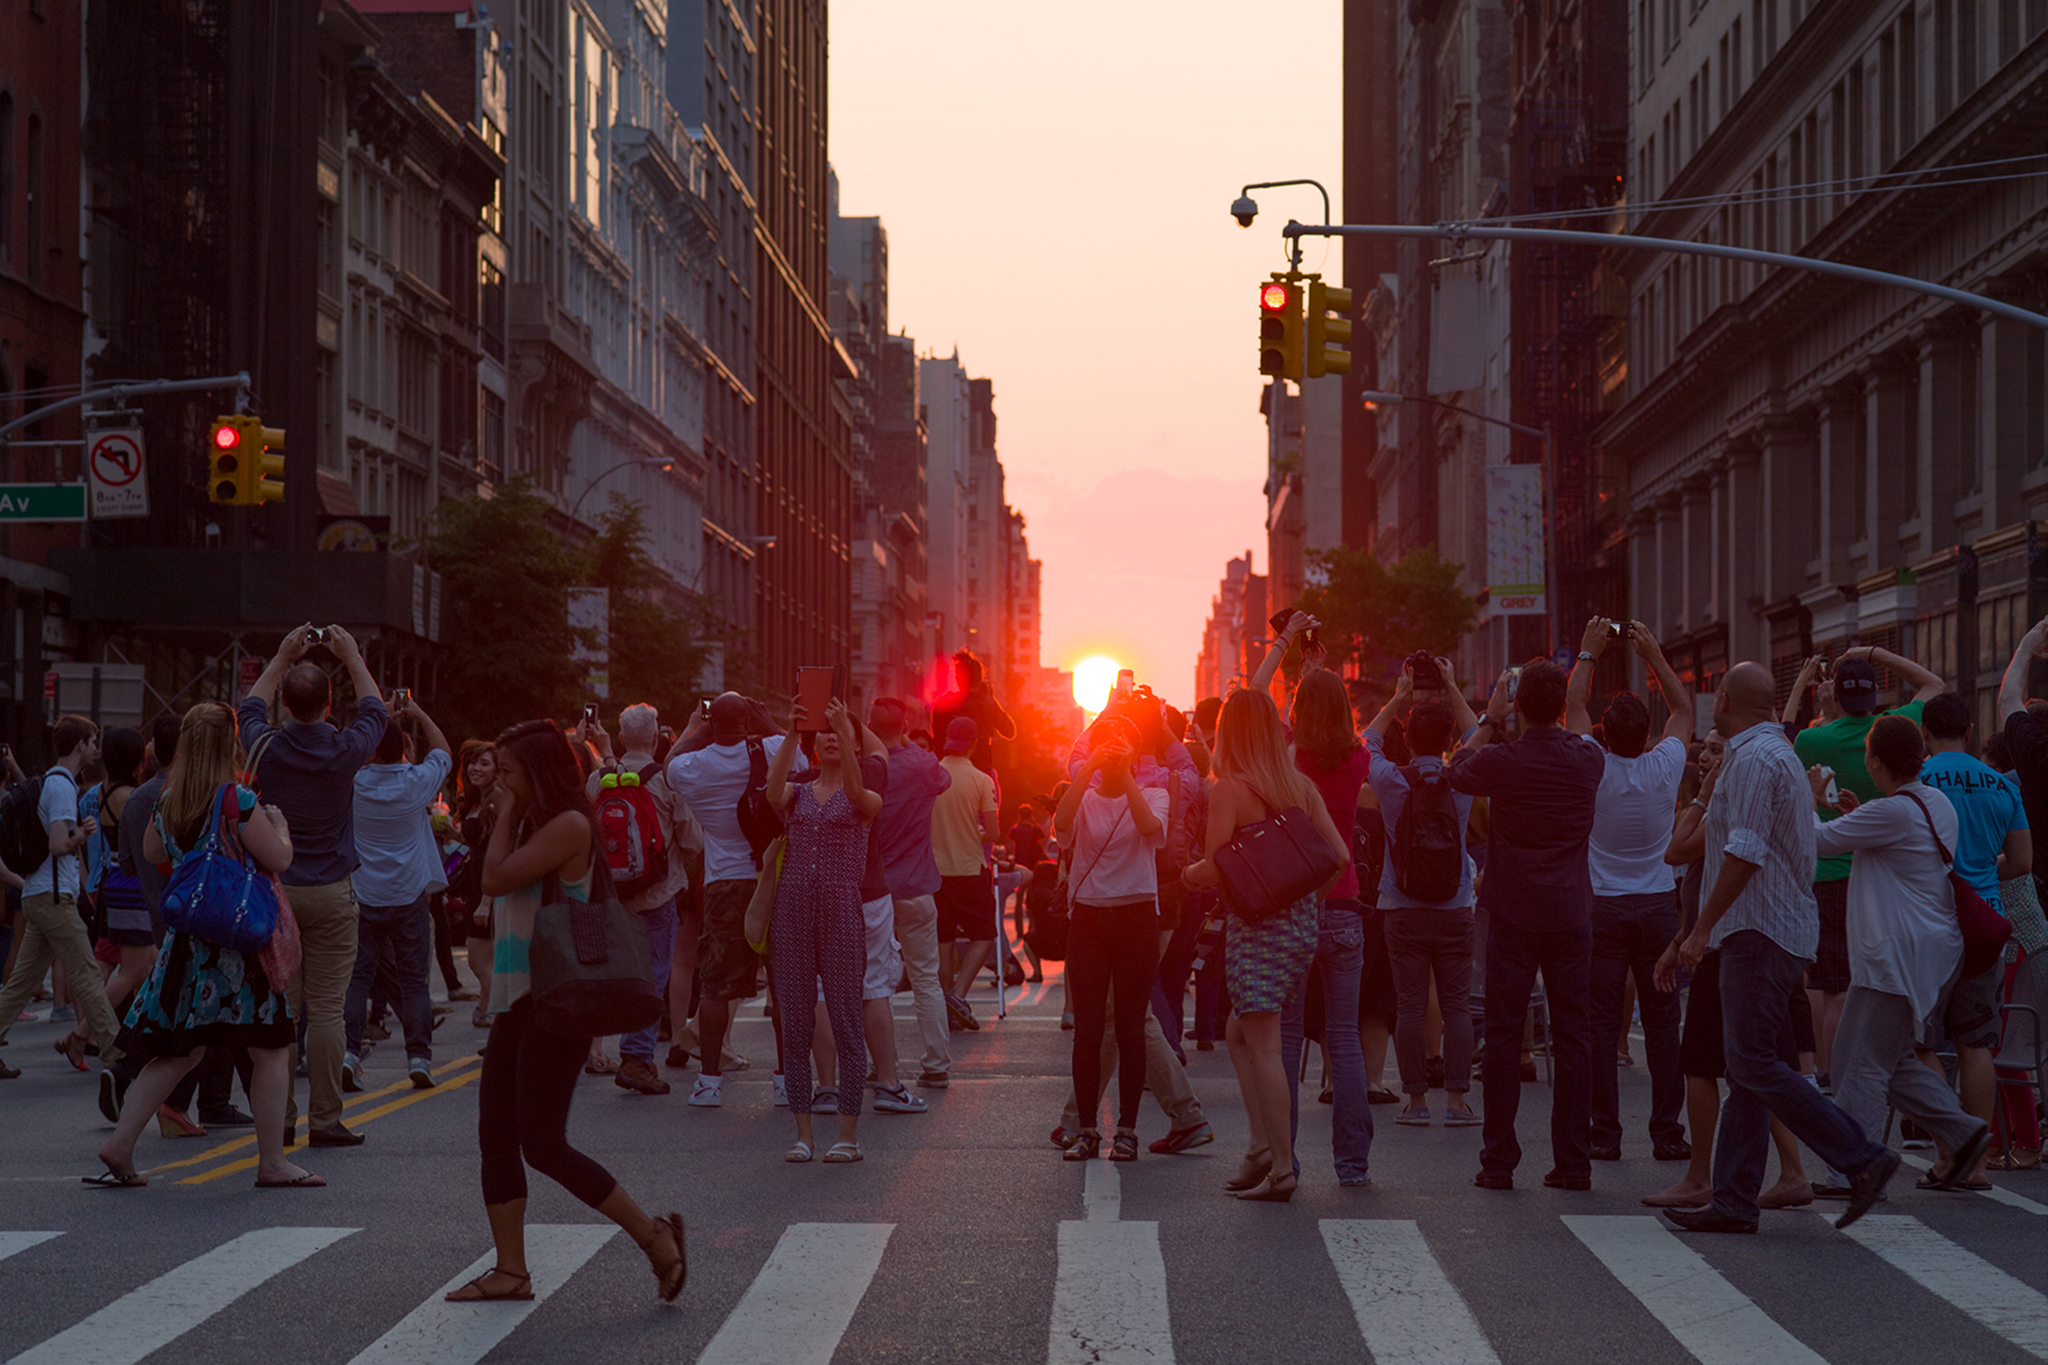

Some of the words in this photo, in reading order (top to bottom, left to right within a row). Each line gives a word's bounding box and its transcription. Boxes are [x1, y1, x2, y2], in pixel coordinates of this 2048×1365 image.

[0, 493, 30, 512] Av
[1500, 597, 1537, 608] GREY
[1921, 770, 2009, 793] KHALIPA
